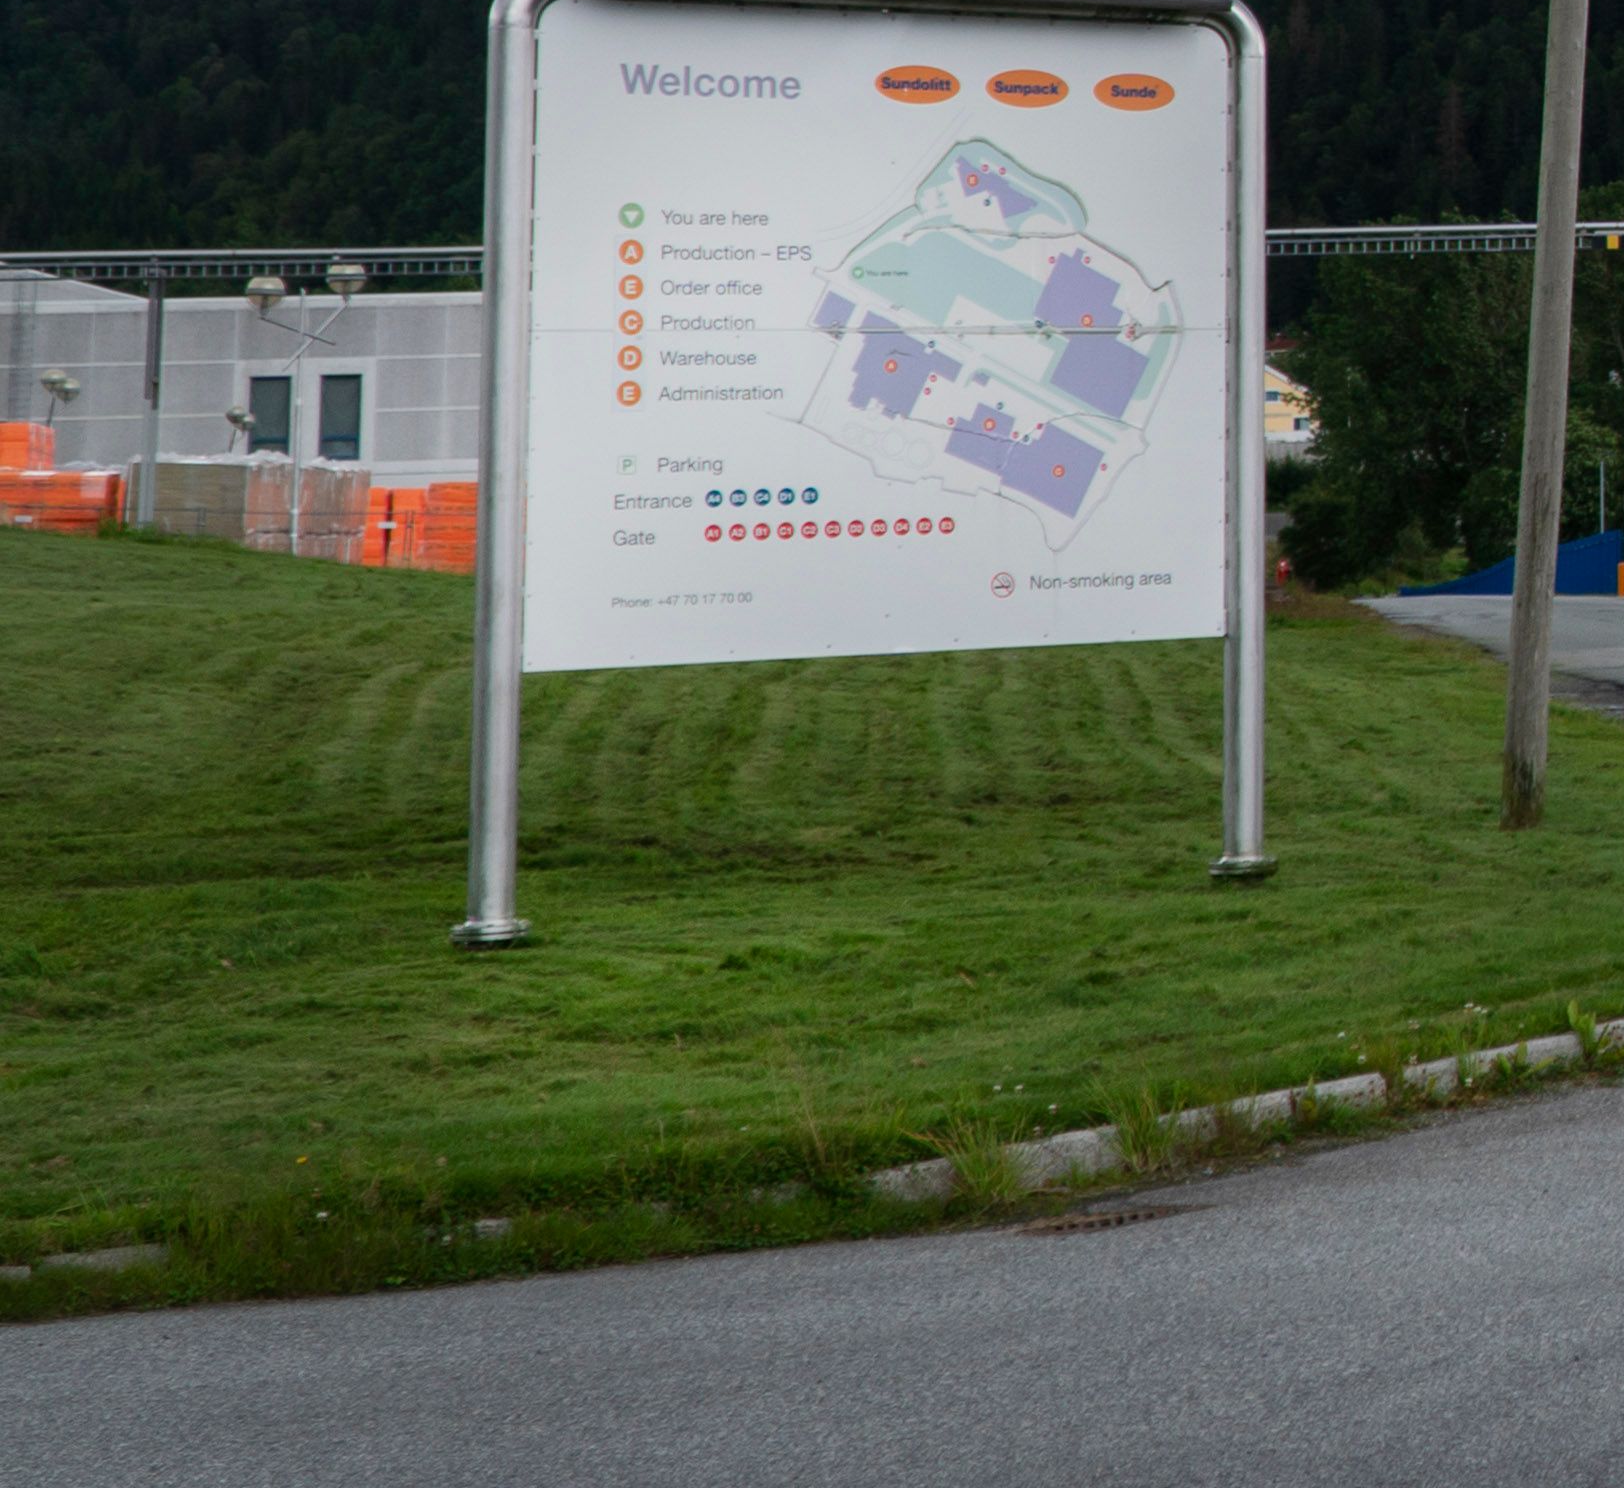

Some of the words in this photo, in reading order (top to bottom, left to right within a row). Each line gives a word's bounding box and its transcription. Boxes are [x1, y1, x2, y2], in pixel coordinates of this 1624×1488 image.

[620, 63, 801, 99] Welcome
[881, 77, 952, 92] Sundolitt
[994, 80, 1059, 96] Sunpack
[1111, 84, 1156, 99] Sunde
[661, 210, 693, 225] You
[700, 214, 726, 226] are
[732, 211, 769, 226] here
[625, 245, 638, 260] A
[661, 244, 755, 261] Production
[776, 246, 812, 261] EPS
[660, 280, 709, 295] Order
[716, 280, 762, 295] office
[624, 315, 638, 330] C
[660, 315, 755, 330] Production
[624, 350, 637, 365] D
[660, 351, 757, 366] Warehouse
[623, 386, 636, 401] E
[659, 386, 783, 401] Administration
[657, 457, 723, 475] Parking
[614, 494, 693, 510] Entrance
[613, 530, 655, 546] Gate
[1030, 573, 1134, 590] Non-smoking
[1139, 573, 1172, 586] area
[611, 597, 652, 608] Phone:
